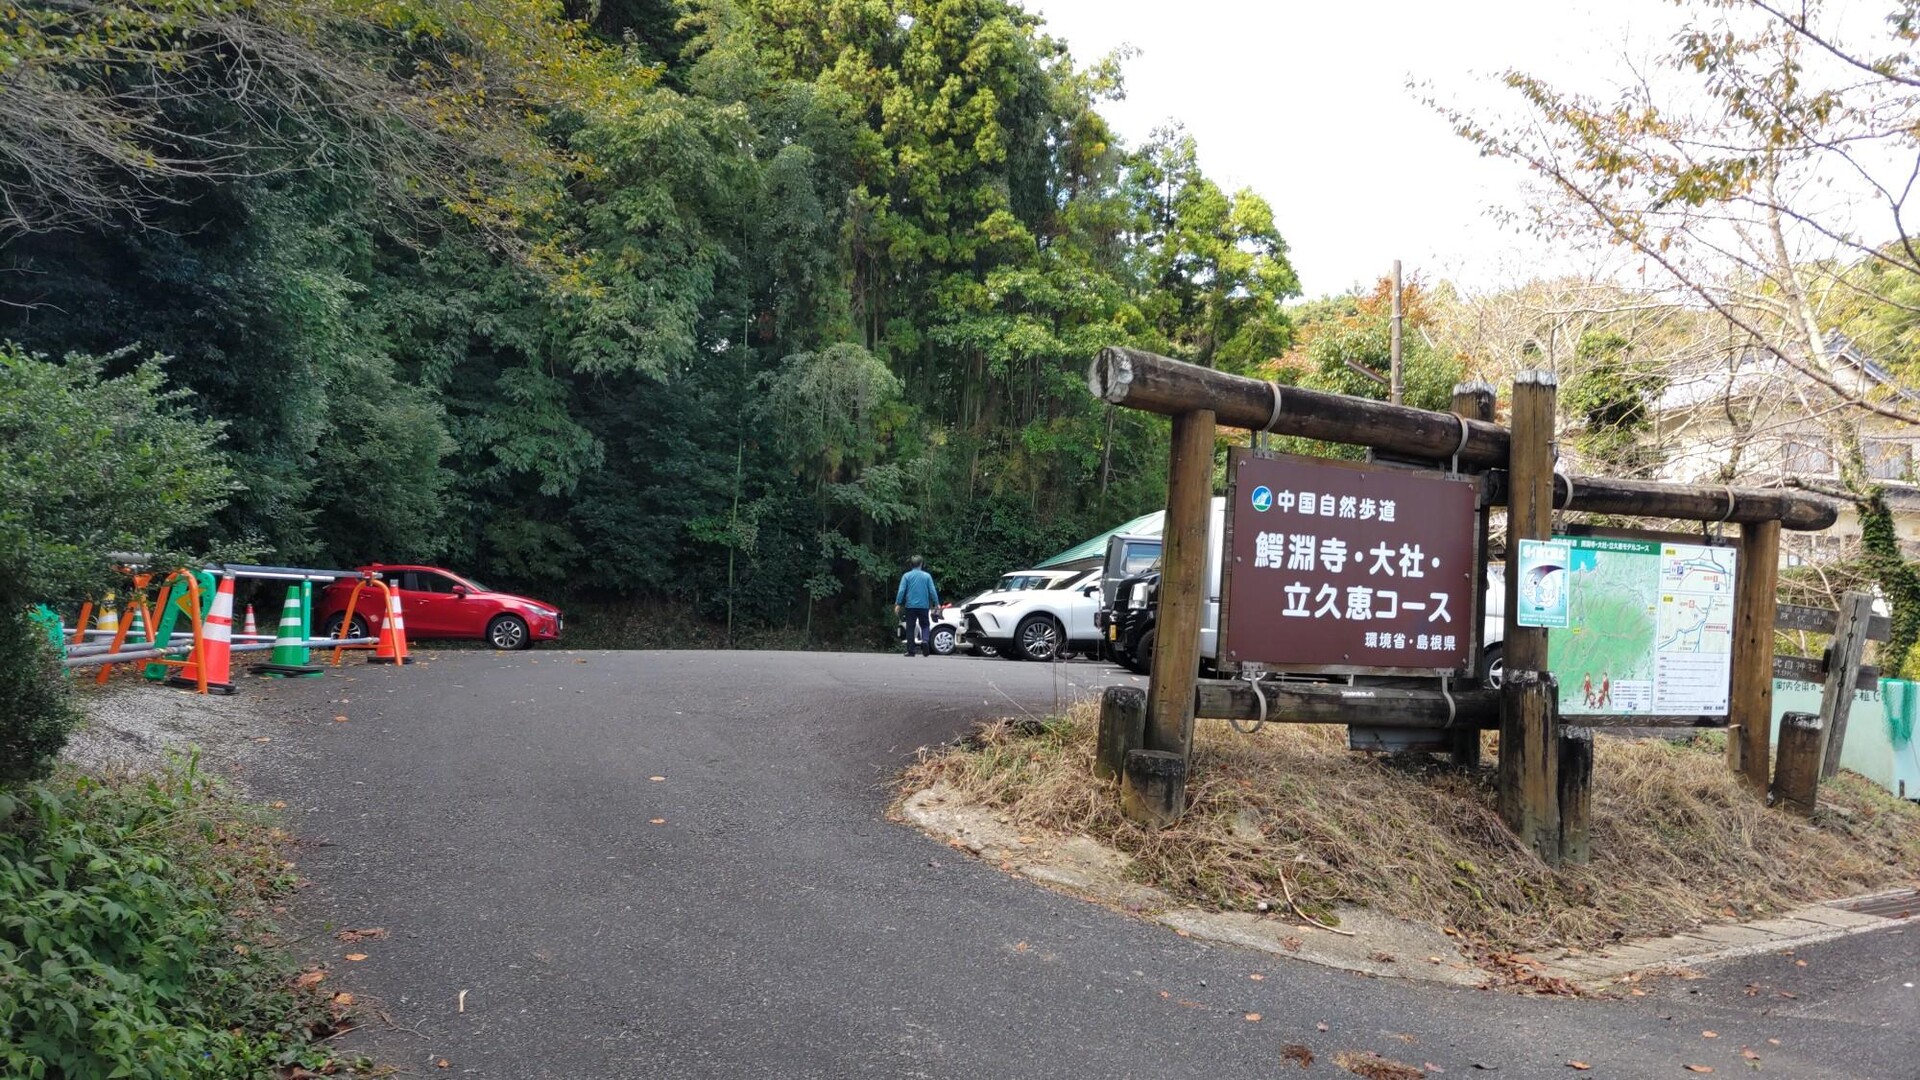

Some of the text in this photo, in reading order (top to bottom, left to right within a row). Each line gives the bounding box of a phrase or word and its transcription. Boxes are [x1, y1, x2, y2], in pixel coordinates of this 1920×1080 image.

[1277, 489, 1396, 523] 中国自然歩道
[1254, 530, 1441, 579] 鰐淵寺・大社・
[1282, 581, 1452, 623] 立久恵コース
[1364, 631, 1456, 651] 環境省・島根県
